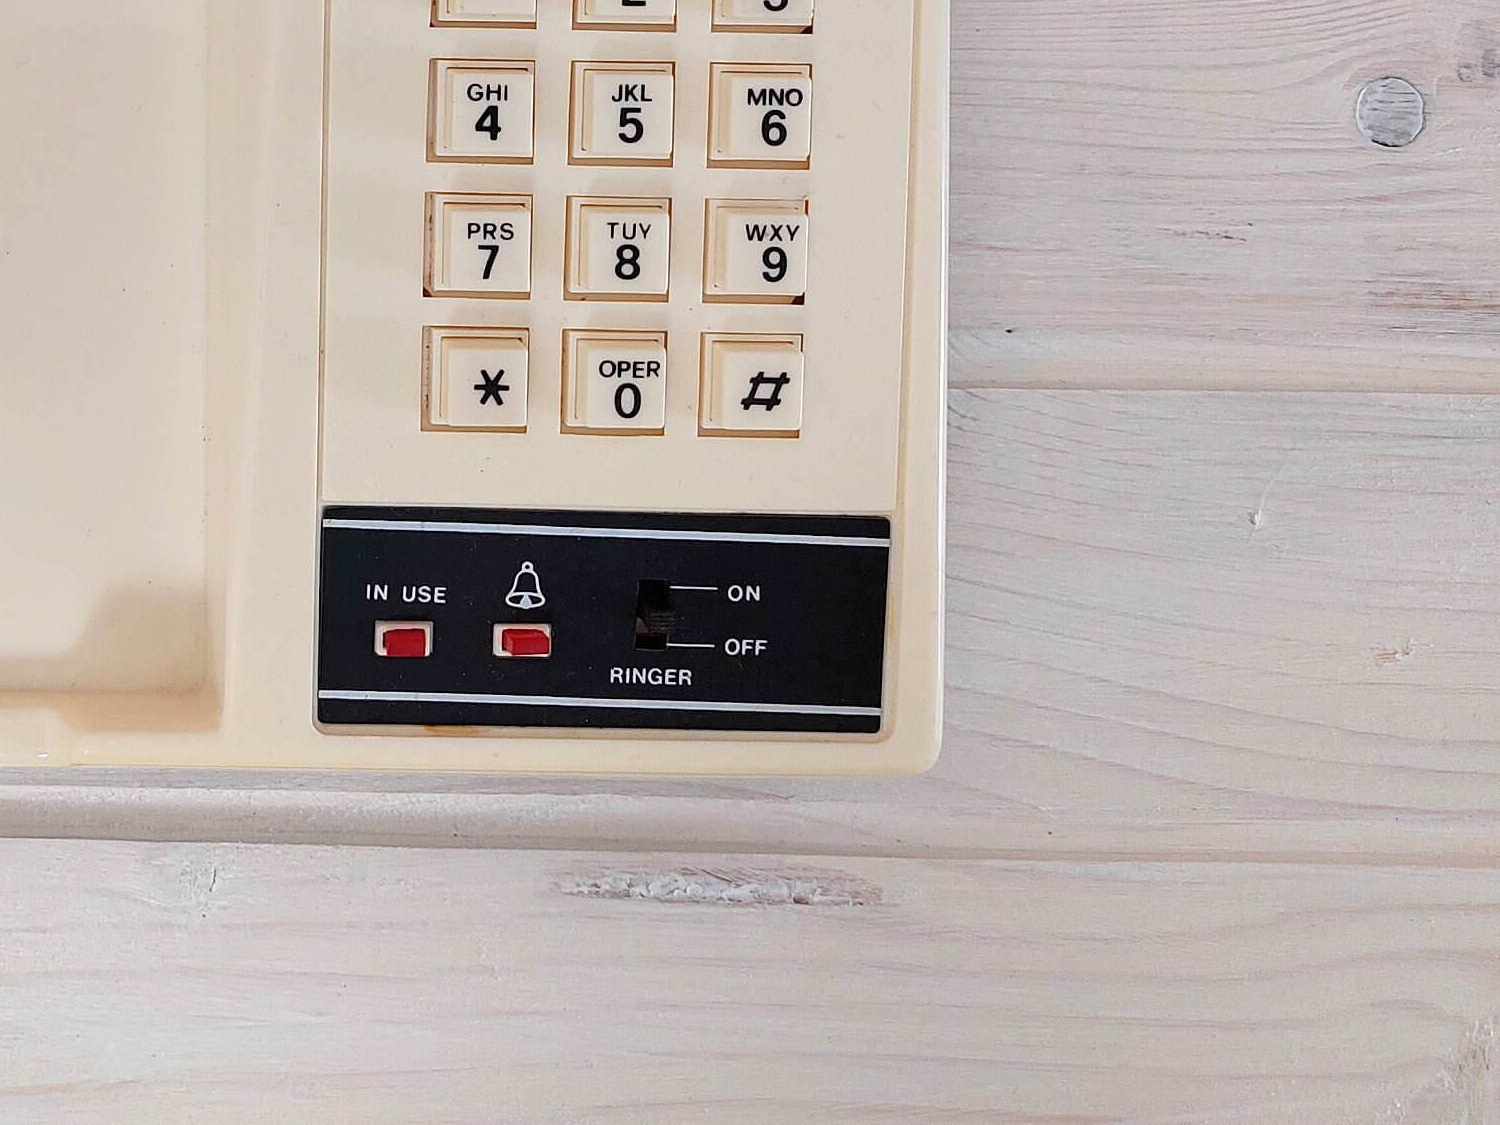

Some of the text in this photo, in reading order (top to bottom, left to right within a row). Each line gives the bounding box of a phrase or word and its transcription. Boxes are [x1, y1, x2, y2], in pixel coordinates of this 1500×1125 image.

[466, 83, 508, 102] GHI
[611, 83, 653, 103] JKL
[747, 88, 803, 107] MNO
[474, 105, 502, 141] 4
[618, 107, 644, 144] 5
[761, 109, 788, 147] 6
[467, 222, 515, 241] PRS
[606, 222, 652, 240] TUY
[745, 223, 800, 242] WXY
[477, 244, 500, 280] 7
[614, 243, 641, 281] 8
[762, 246, 788, 283] 9
[598, 359, 661, 379] OPER
[614, 382, 642, 419] 0
[366, 584, 447, 604] IN USE
[727, 584, 760, 602] ON
[724, 638, 768, 656] OFF
[610, 666, 692, 686] RINGER
